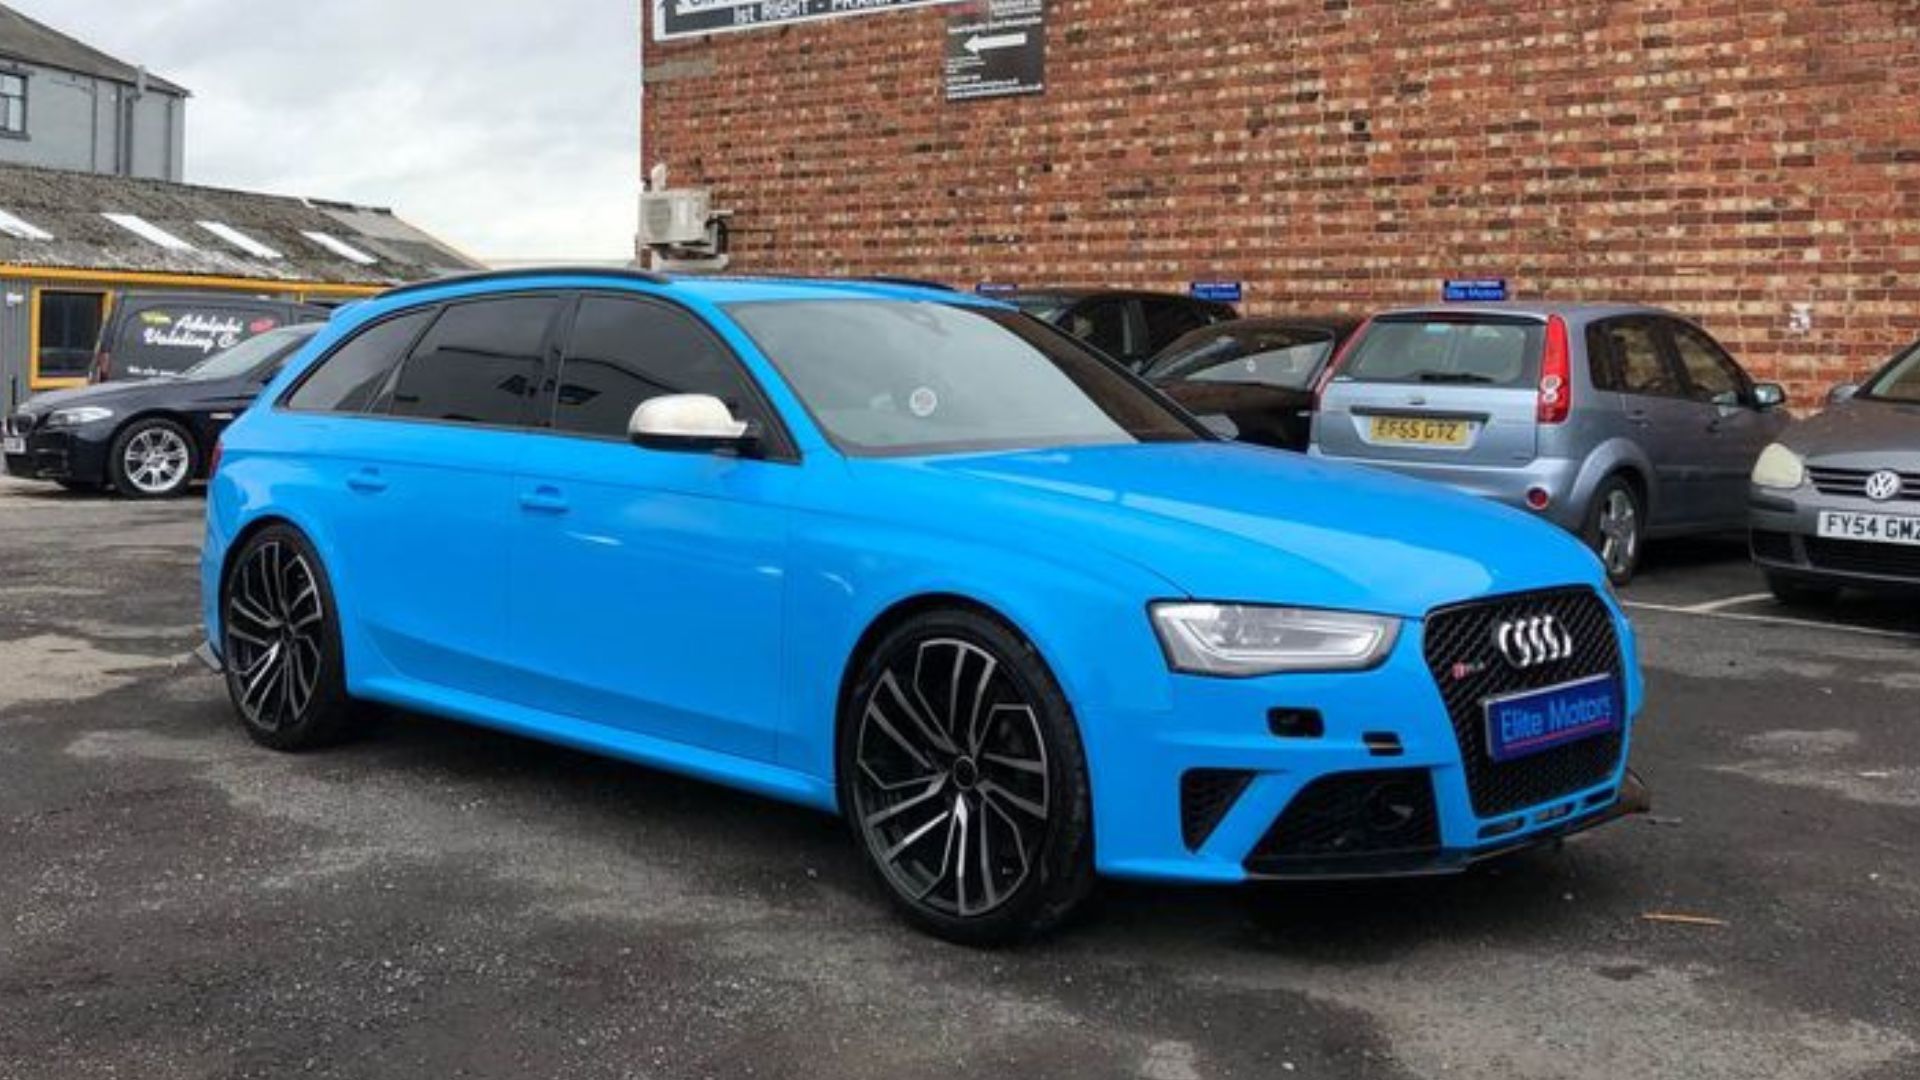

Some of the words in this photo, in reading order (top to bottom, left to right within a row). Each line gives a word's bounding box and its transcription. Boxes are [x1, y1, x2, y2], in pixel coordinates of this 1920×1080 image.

[1826, 513, 1879, 537] FY54
[1501, 708, 1544, 743] Elite
[1548, 695, 1613, 731] Motors
